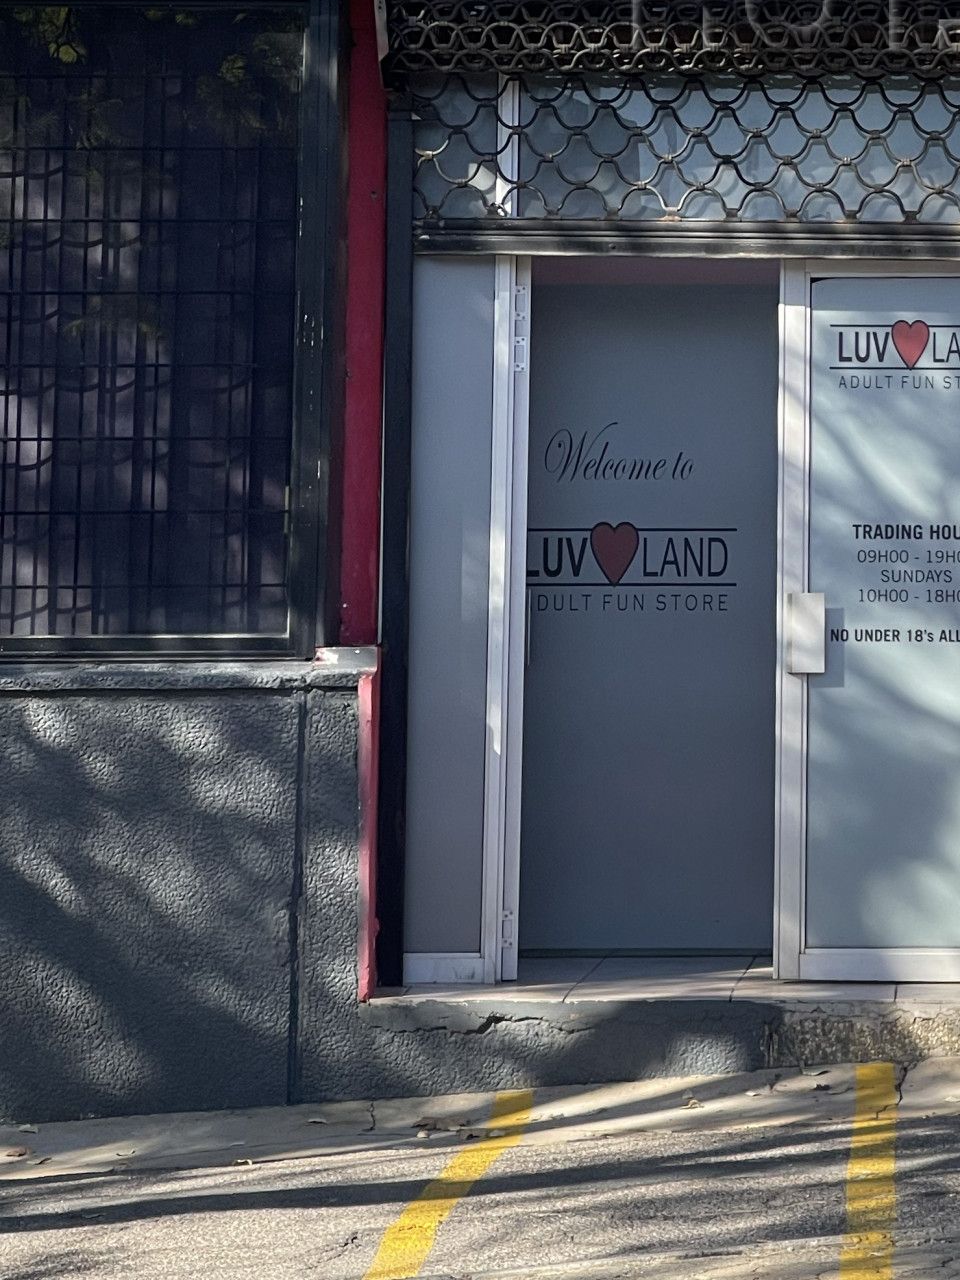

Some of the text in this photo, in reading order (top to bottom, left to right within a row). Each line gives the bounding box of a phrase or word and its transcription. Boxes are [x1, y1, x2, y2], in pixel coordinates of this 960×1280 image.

[838, 331, 890, 363] LUV
[838, 375, 893, 389] ADULT
[901, 375, 934, 389] FUN
[544, 422, 695, 483] Welcome to
[852, 524, 923, 540] TRADING
[642, 537, 728, 578] LAND
[857, 549, 909, 564] 09H00
[880, 569, 953, 583] SUNDAYS
[536, 593, 729, 612] DULT FUN STORE
[858, 588, 909, 603] 10H00
[830, 628, 849, 643] NO
[854, 628, 901, 643] UNDER
